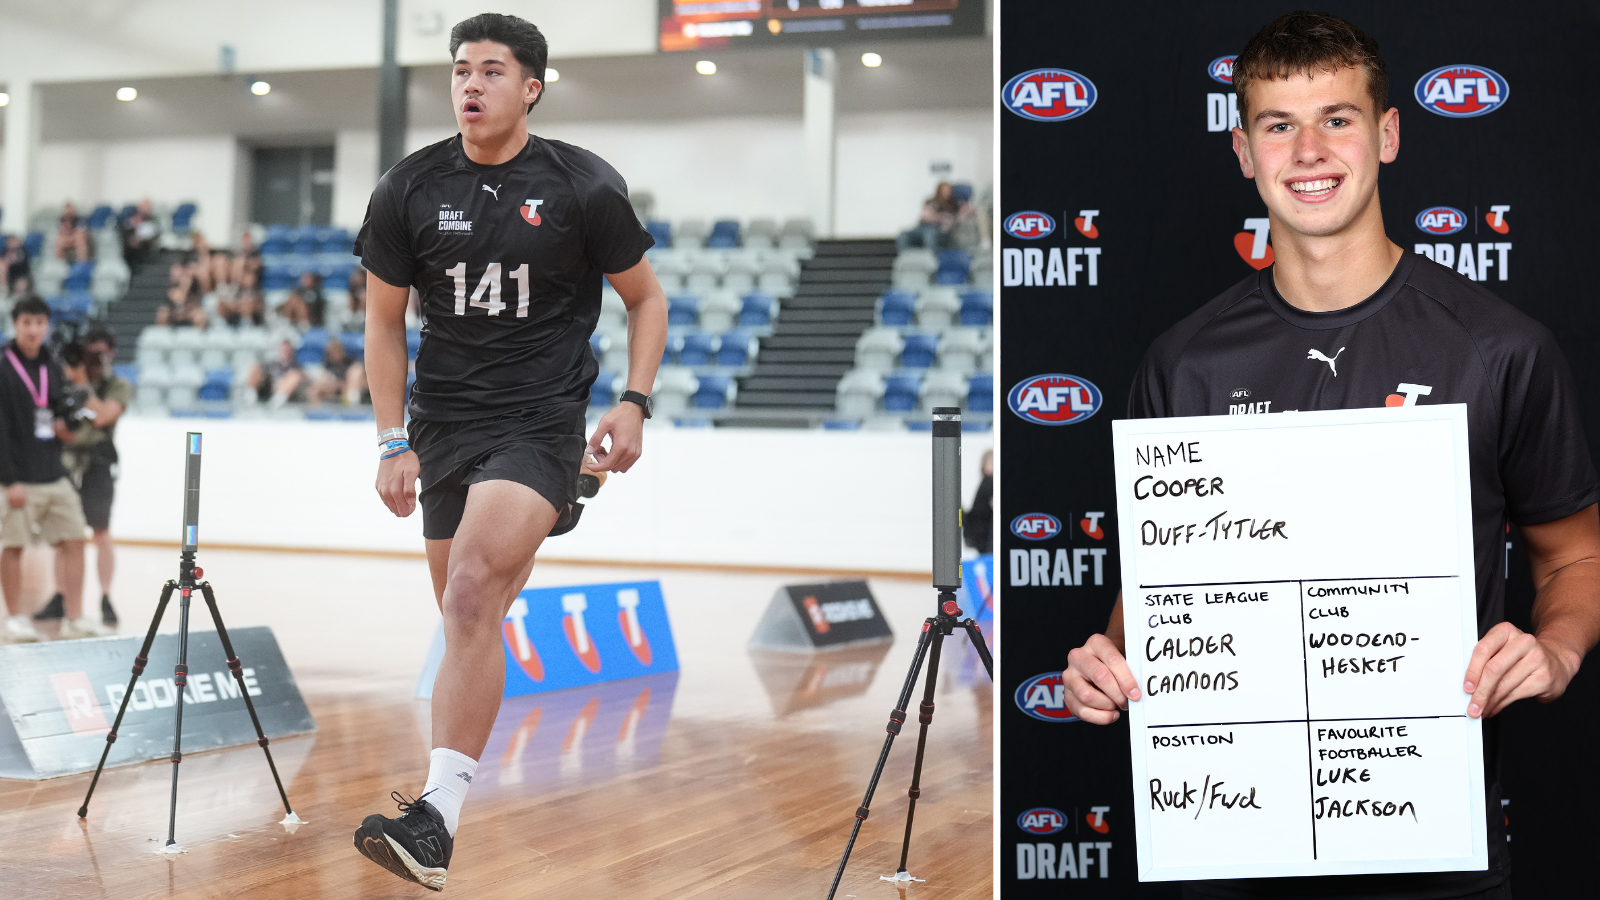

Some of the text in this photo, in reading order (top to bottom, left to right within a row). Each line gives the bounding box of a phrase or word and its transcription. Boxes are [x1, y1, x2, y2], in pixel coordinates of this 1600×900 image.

[1011, 81, 1089, 107] AFL
[1424, 77, 1501, 104] AFL
[438, 210, 465, 221] DRAFT
[525, 199, 544, 219] T
[1009, 209, 1100, 232] AFL T
[1421, 204, 1511, 228] AFL T
[438, 220, 473, 232] COMBINE
[1243, 217, 1270, 260] T
[1002, 247, 1102, 287] DRAFT
[445, 262, 530, 318] 141
[1017, 386, 1094, 412] AFL
[1232, 390, 1249, 398] AFL
[1136, 441, 1203, 468] NAME
[1133, 475, 1225, 501] COOPER
[1016, 511, 1105, 534] AFL T
[1141, 510, 1289, 547] DUFF-TYTLER
[1009, 548, 1107, 587] DRAFT
[1145, 591, 1269, 607] STATE LEAGUE
[1307, 582, 1410, 597] COMMUNITY
[1148, 613, 1193, 629] CLUB
[1309, 606, 1350, 620] CLUB
[1146, 633, 1236, 662] CALDER
[1322, 655, 1405, 678] HESKET
[105, 672, 219, 714] ROOKIE
[217, 667, 263, 701] ME
[1147, 670, 1239, 697] CANNONS
[1152, 731, 1234, 750] POSITION
[1317, 725, 1409, 741] FAVOURITE
[1318, 744, 1423, 761] FOOTBALLER
[1316, 767, 1371, 787] LUKE
[1149, 774, 1262, 820] Ruck/Fwd
[1023, 806, 1110, 828] AFL T
[1315, 796, 1418, 823] JACKSON
[1016, 842, 1112, 880] DRAFT
